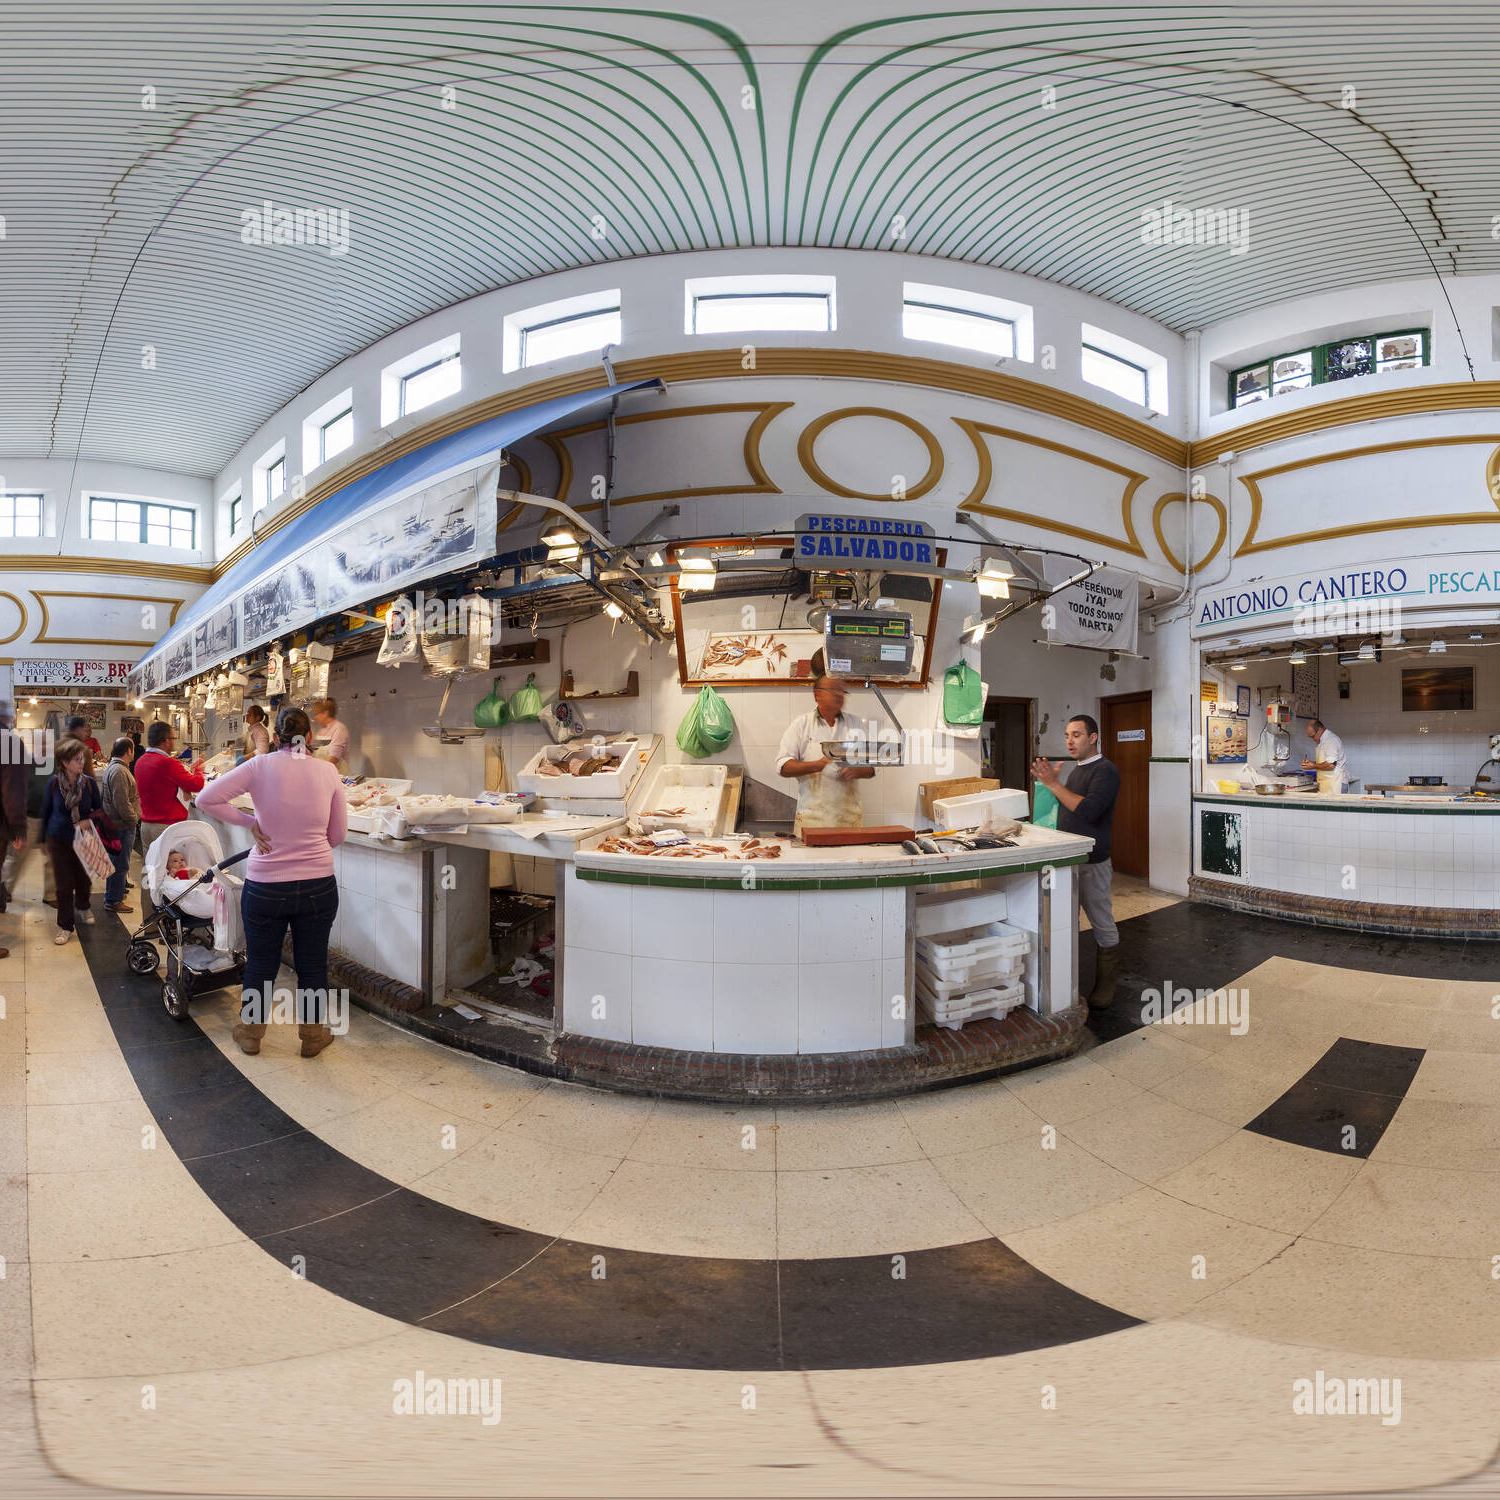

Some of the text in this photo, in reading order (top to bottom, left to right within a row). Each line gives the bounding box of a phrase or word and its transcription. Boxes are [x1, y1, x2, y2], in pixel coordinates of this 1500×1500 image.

[808, 517, 924, 536] PESCADERIA
[801, 535, 932, 563] SALVADOR
[1200, 585, 1288, 623] ANTONIO
[1298, 568, 1407, 603] CANTERO
[1068, 601, 1095, 617] TODOS
[1078, 617, 1114, 632] MARTA
[22, 661, 69, 669] PESCADOS
[26, 668, 71, 676] MARISCOS
[63, 676, 91, 684] 956
